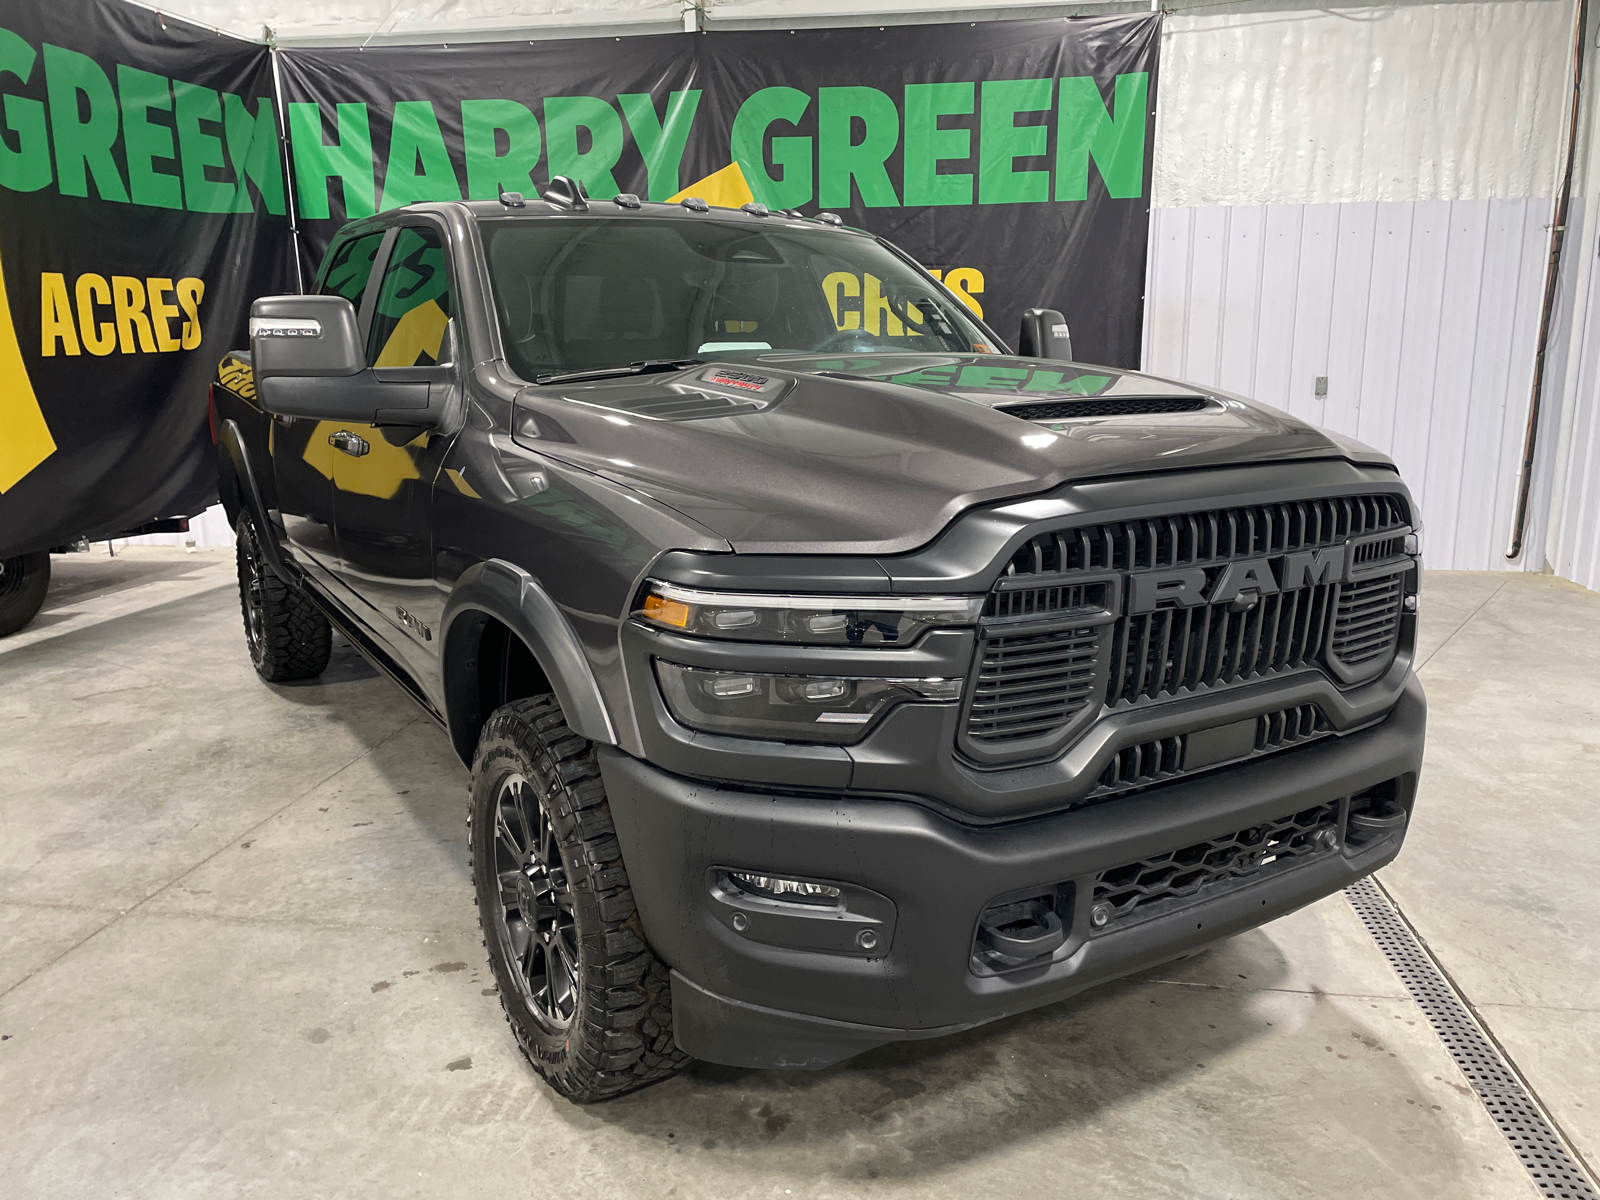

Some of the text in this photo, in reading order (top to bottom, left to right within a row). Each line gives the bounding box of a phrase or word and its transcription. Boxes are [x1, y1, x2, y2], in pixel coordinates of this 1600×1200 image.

[0, 27, 287, 217] GREEN
[288, 72, 1148, 220] HARRY GREEN
[41, 271, 205, 357] ACRES
[1130, 545, 1345, 617] RAM
